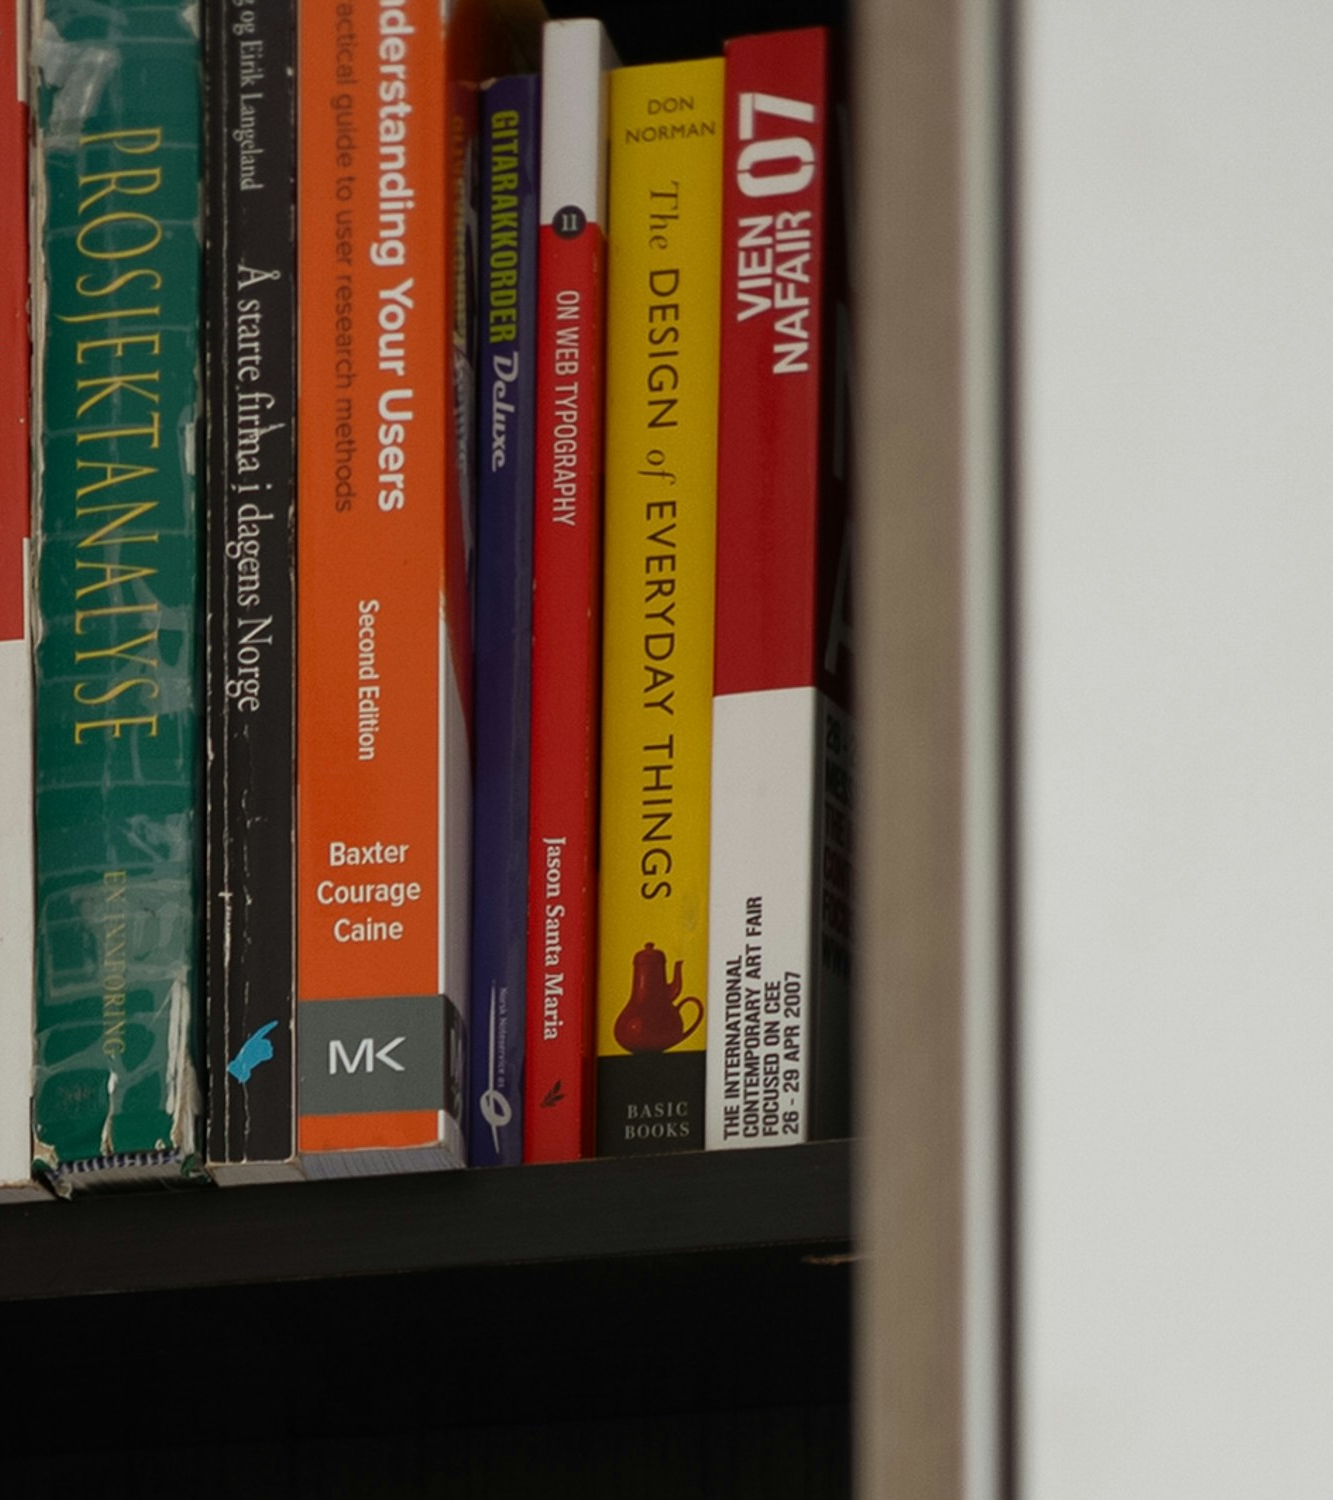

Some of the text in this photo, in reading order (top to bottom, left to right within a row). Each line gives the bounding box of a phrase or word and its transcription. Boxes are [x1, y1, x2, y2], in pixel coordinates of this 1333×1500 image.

[625, 122, 717, 143] NORMAN
[647, 96, 694, 114] DON
[237, 264, 281, 291] Å
[489, 110, 520, 472] GITARAKKORDER Deluxe
[236, 299, 269, 382] starte
[55, 126, 162, 745] PROSJEKTANALYSE
[237, 390, 274, 474] firma
[378, 278, 415, 511] Your Users
[552, 290, 581, 525] ON WEB TYPOGRAPHY
[226, 503, 274, 606] dagens
[637, 181, 680, 900] The DESIGN of EVERYDAY THINGS
[226, 616, 274, 713] Norge
[316, 880, 422, 906] Courage
[330, 842, 409, 866] Baxter
[333, 919, 404, 942] Caine
[543, 835, 568, 1040] Jason Santa Maria
[723, 958, 742, 1140] THE INTERNATIONAL
[743, 896, 763, 1138] CONTEMPORARY ART FAIR
